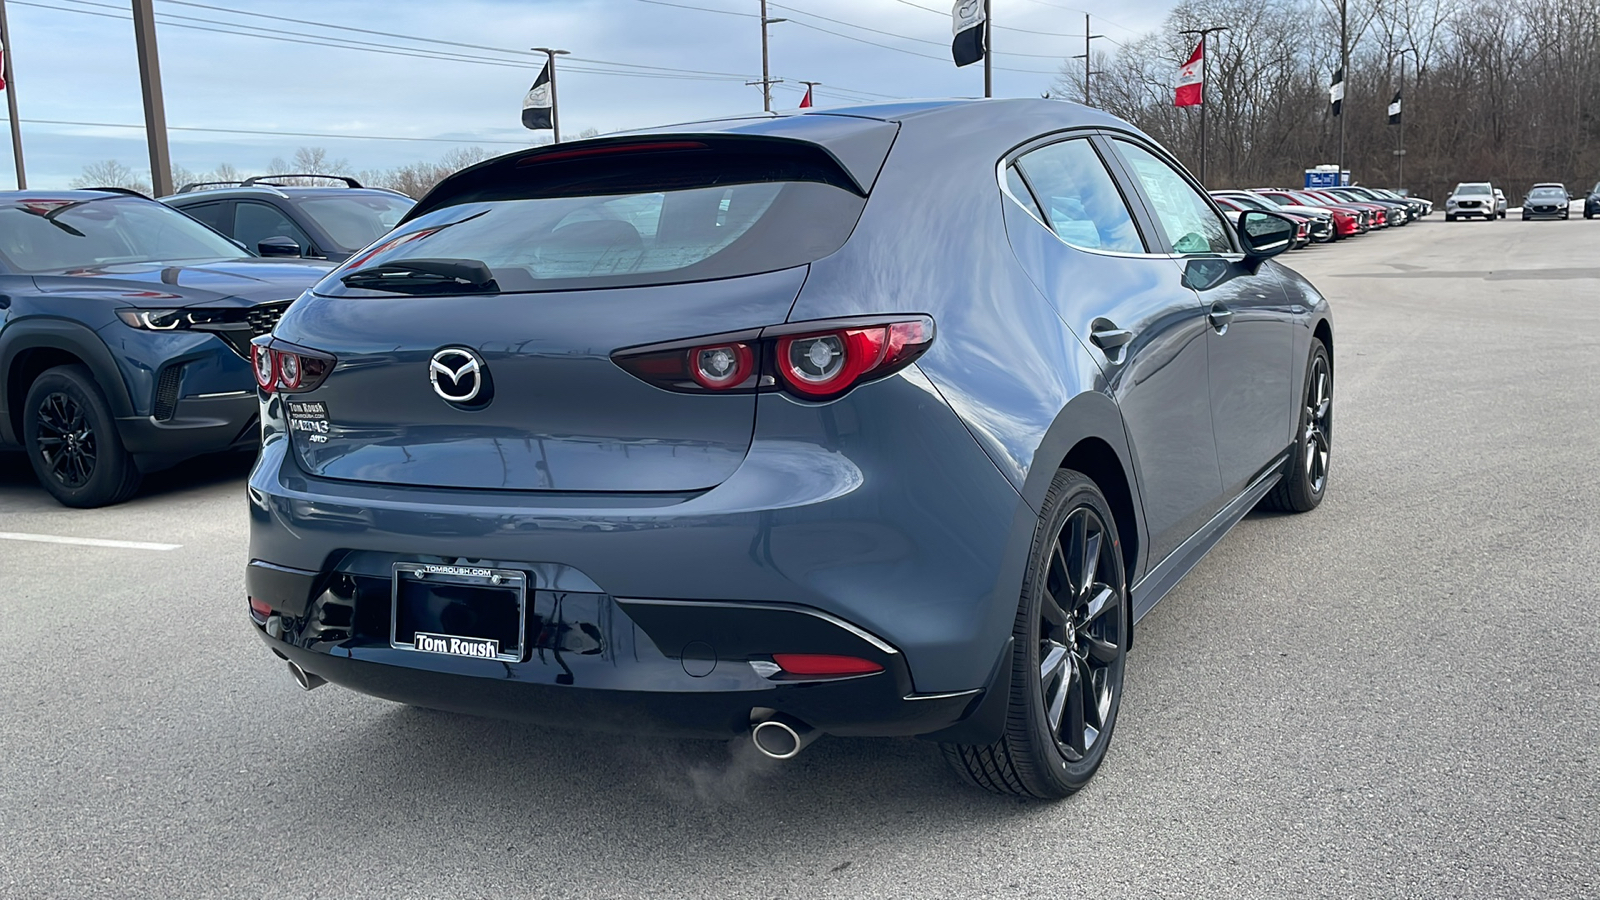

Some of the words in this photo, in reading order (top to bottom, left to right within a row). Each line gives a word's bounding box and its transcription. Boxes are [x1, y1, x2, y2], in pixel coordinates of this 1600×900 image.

[309, 434, 328, 443] AWD
[425, 565, 491, 577] TOMROUSH.COM
[417, 635, 448, 653] Tom
[450, 638, 496, 658] Roush
